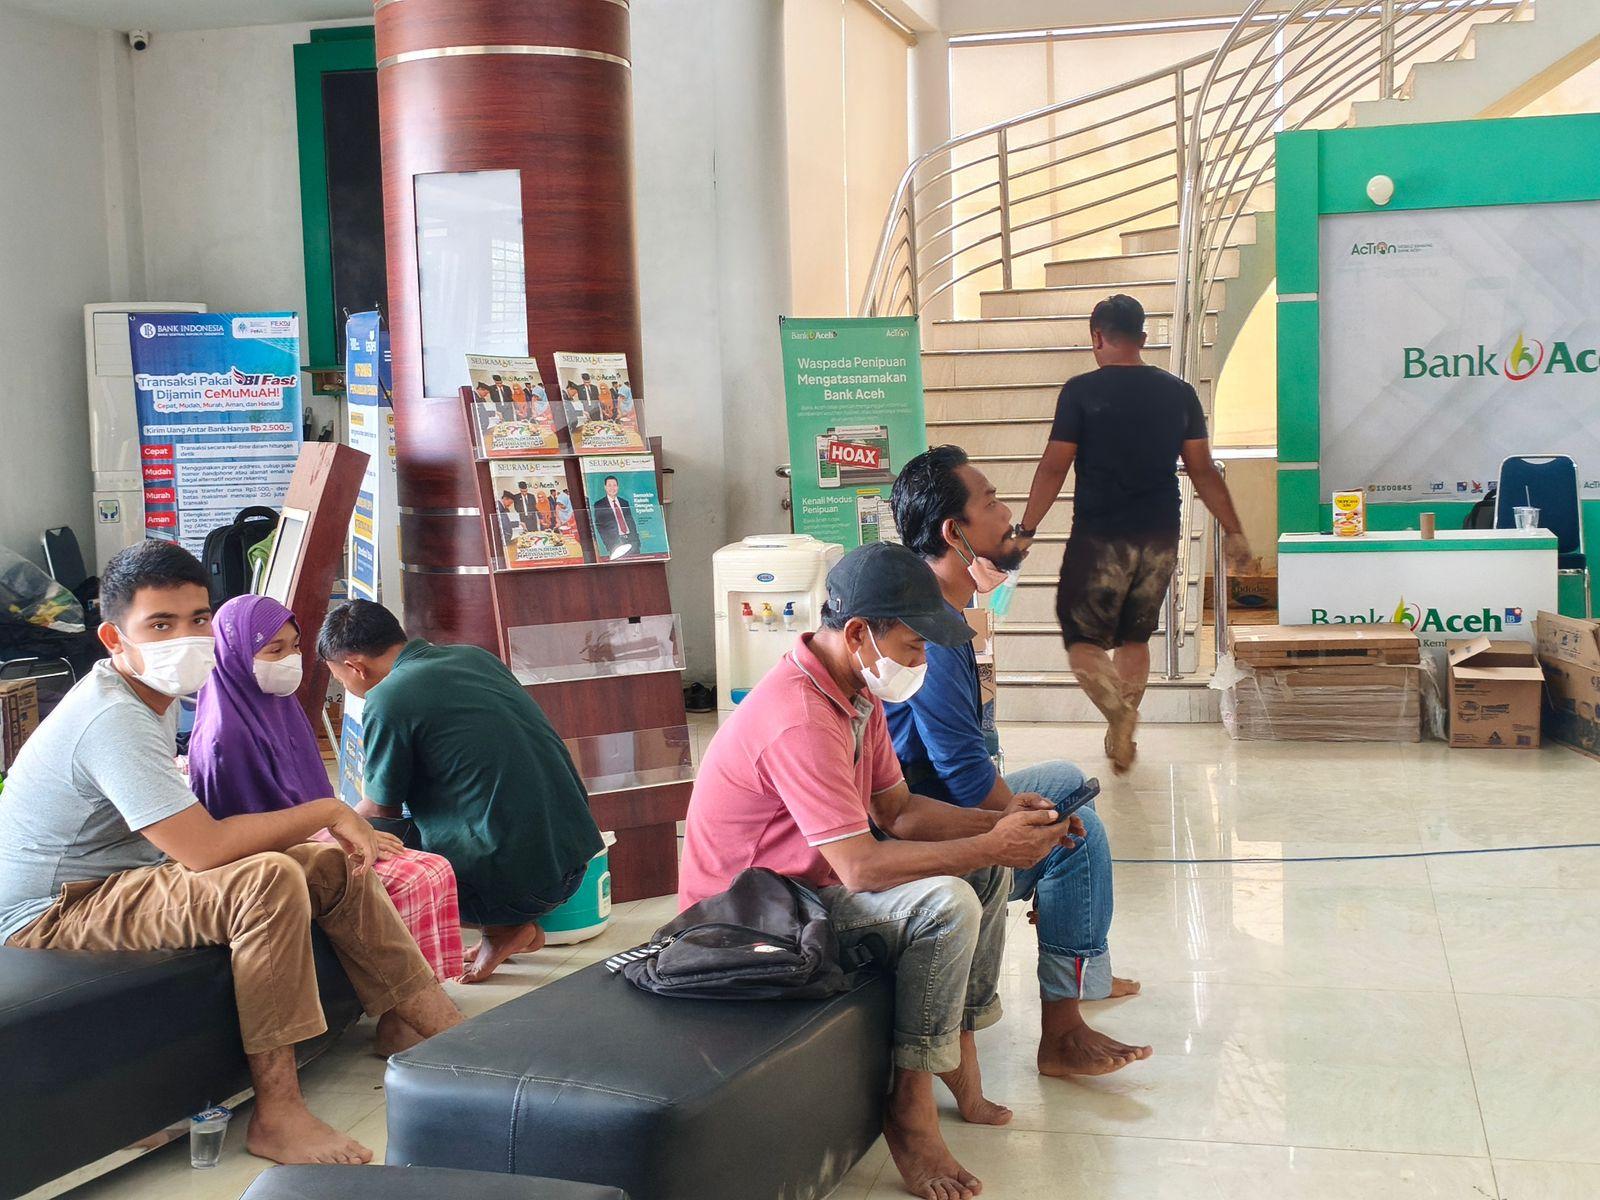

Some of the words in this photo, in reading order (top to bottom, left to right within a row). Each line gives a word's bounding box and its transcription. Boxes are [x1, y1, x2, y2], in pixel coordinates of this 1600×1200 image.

[157, 324, 179, 333] BANK
[180, 324, 225, 333] INDONESIA
[791, 331, 809, 340] Bank
[815, 331, 835, 339] Aceh
[797, 358, 852, 371] Waspada
[854, 356, 907, 369] Penipuan
[1403, 344, 1500, 379] Bank
[1543, 341, 1600, 375] Ac
[139, 376, 197, 387] Transaksi
[199, 375, 233, 386] Pakai
[243, 375, 259, 386] BI
[261, 375, 297, 386] Fast
[797, 372, 907, 387] Mengatasnamakan
[157, 389, 202, 402] Dijamin
[204, 388, 280, 399] CeMuMuAH!
[824, 388, 854, 401] Bank
[855, 387, 885, 400] Aceh
[166, 427, 186, 435] Uang
[227, 426, 250, 434] Hanya
[250, 424, 261, 433] Rp
[144, 448, 168, 457] Cepat
[831, 445, 878, 464] HOAX
[145, 468, 172, 476] Mudah
[802, 496, 826, 505] Kenali
[826, 494, 853, 504] Modus
[802, 505, 839, 515] Penipuan
[1311, 608, 1385, 625] Bank
[1419, 607, 1503, 633] Aceh
